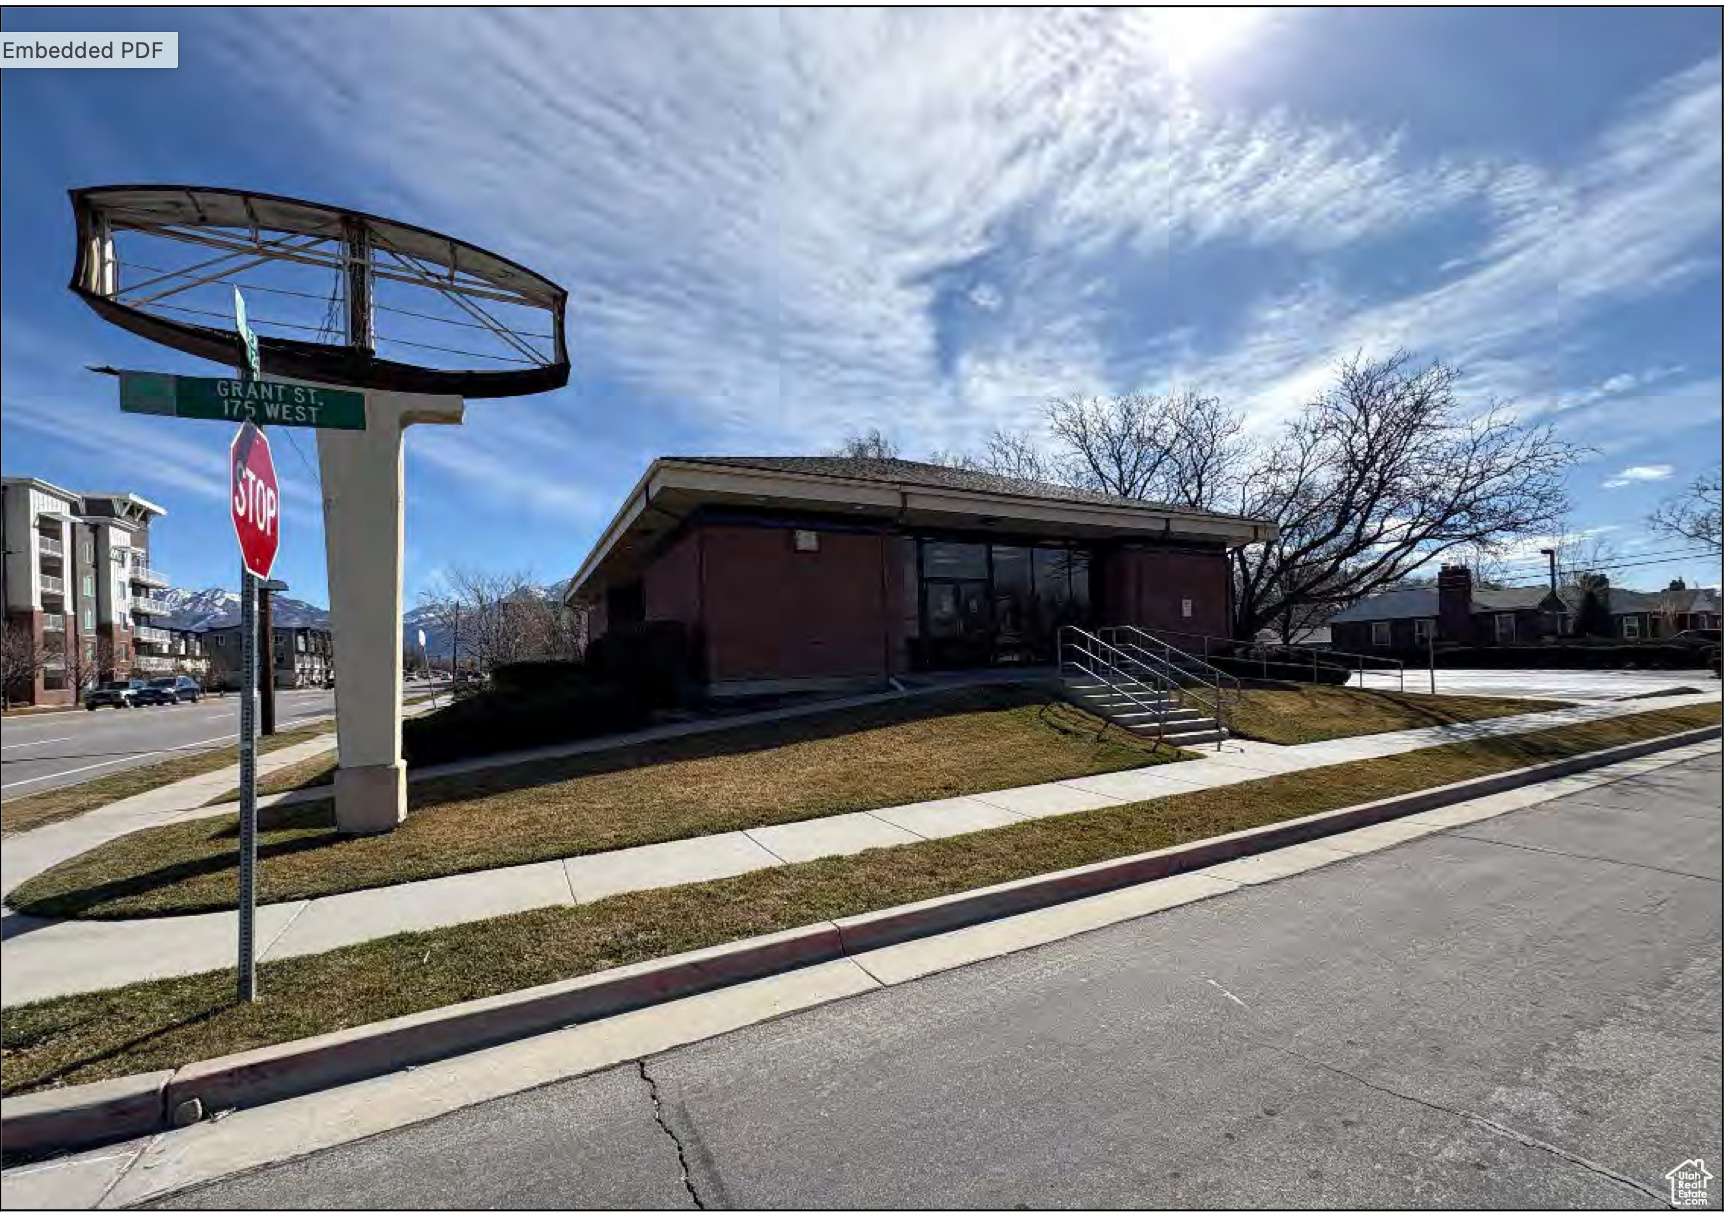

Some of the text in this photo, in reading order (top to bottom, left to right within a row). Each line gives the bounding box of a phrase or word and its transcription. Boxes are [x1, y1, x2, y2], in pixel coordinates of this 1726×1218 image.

[216, 380, 325, 407] GRANT ST.
[223, 398, 319, 424] 175 WEST
[234, 459, 276, 537] STOP
